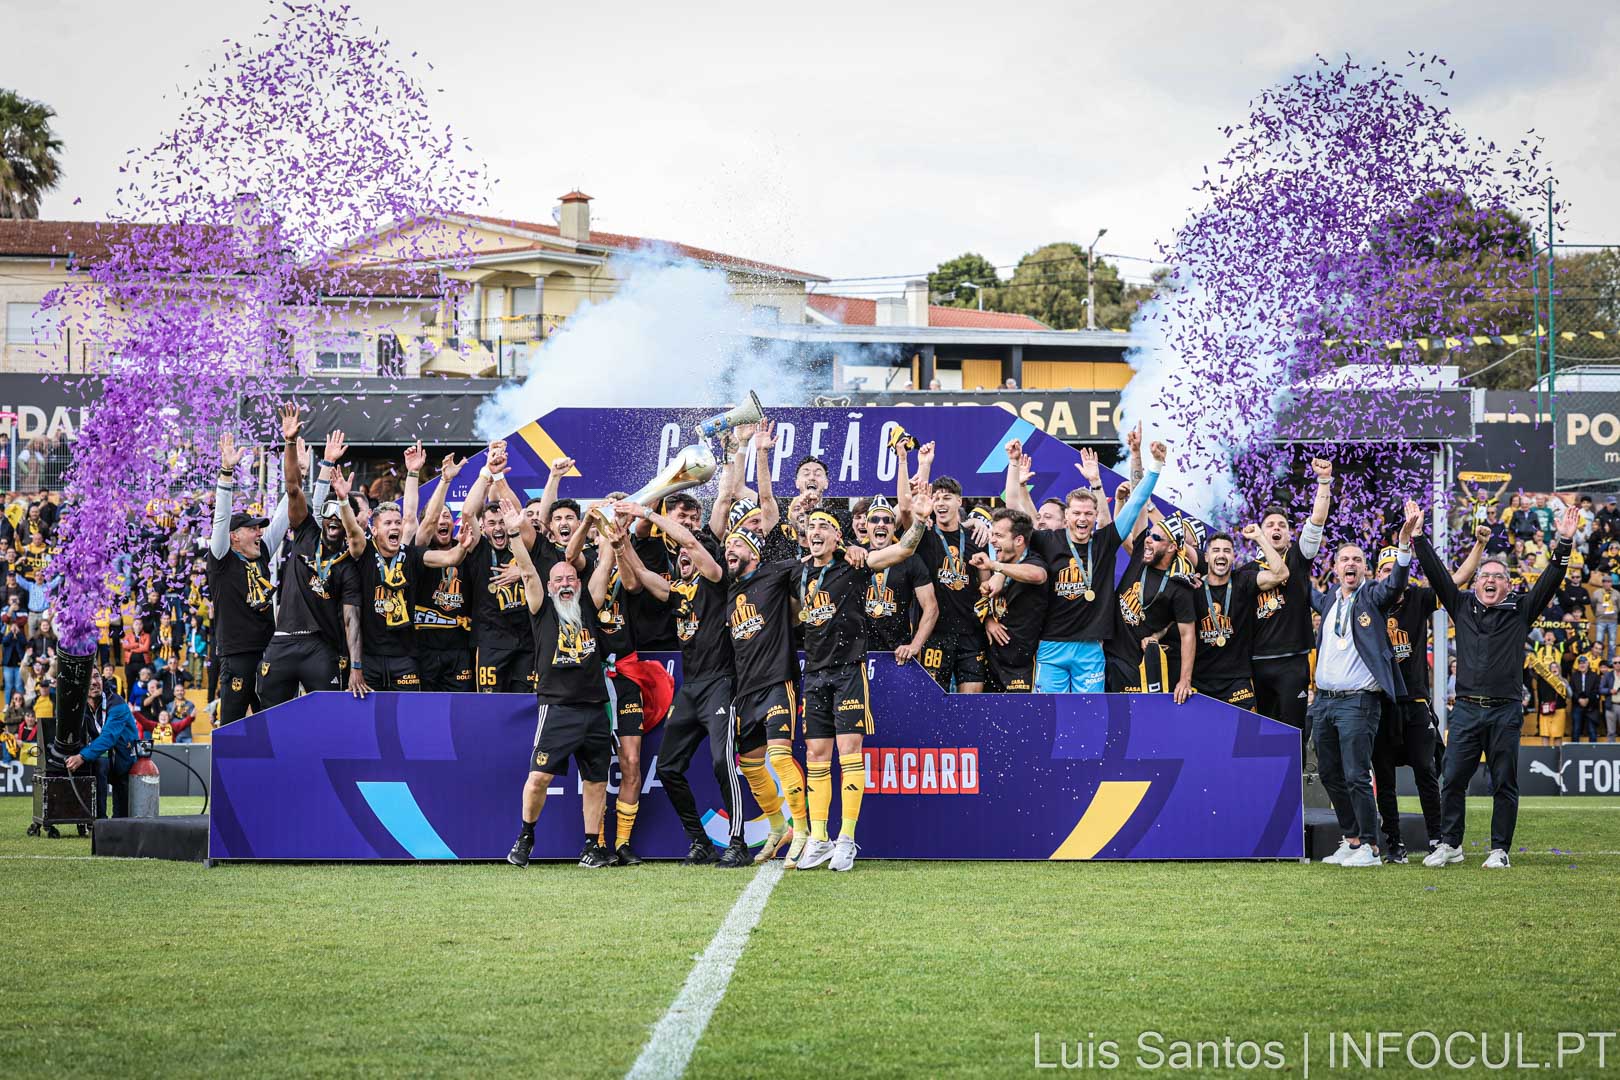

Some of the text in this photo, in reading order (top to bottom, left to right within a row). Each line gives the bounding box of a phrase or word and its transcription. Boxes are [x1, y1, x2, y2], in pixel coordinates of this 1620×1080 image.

[657, 411, 899, 482] CPEÃO
[453, 490, 468, 498] LIG
[924, 648, 943, 668] 88
[480, 666, 497, 686] 85
[842, 698, 860, 706] CASA
[1232, 688, 1249, 697] CASA
[864, 752, 978, 789] LACARD
